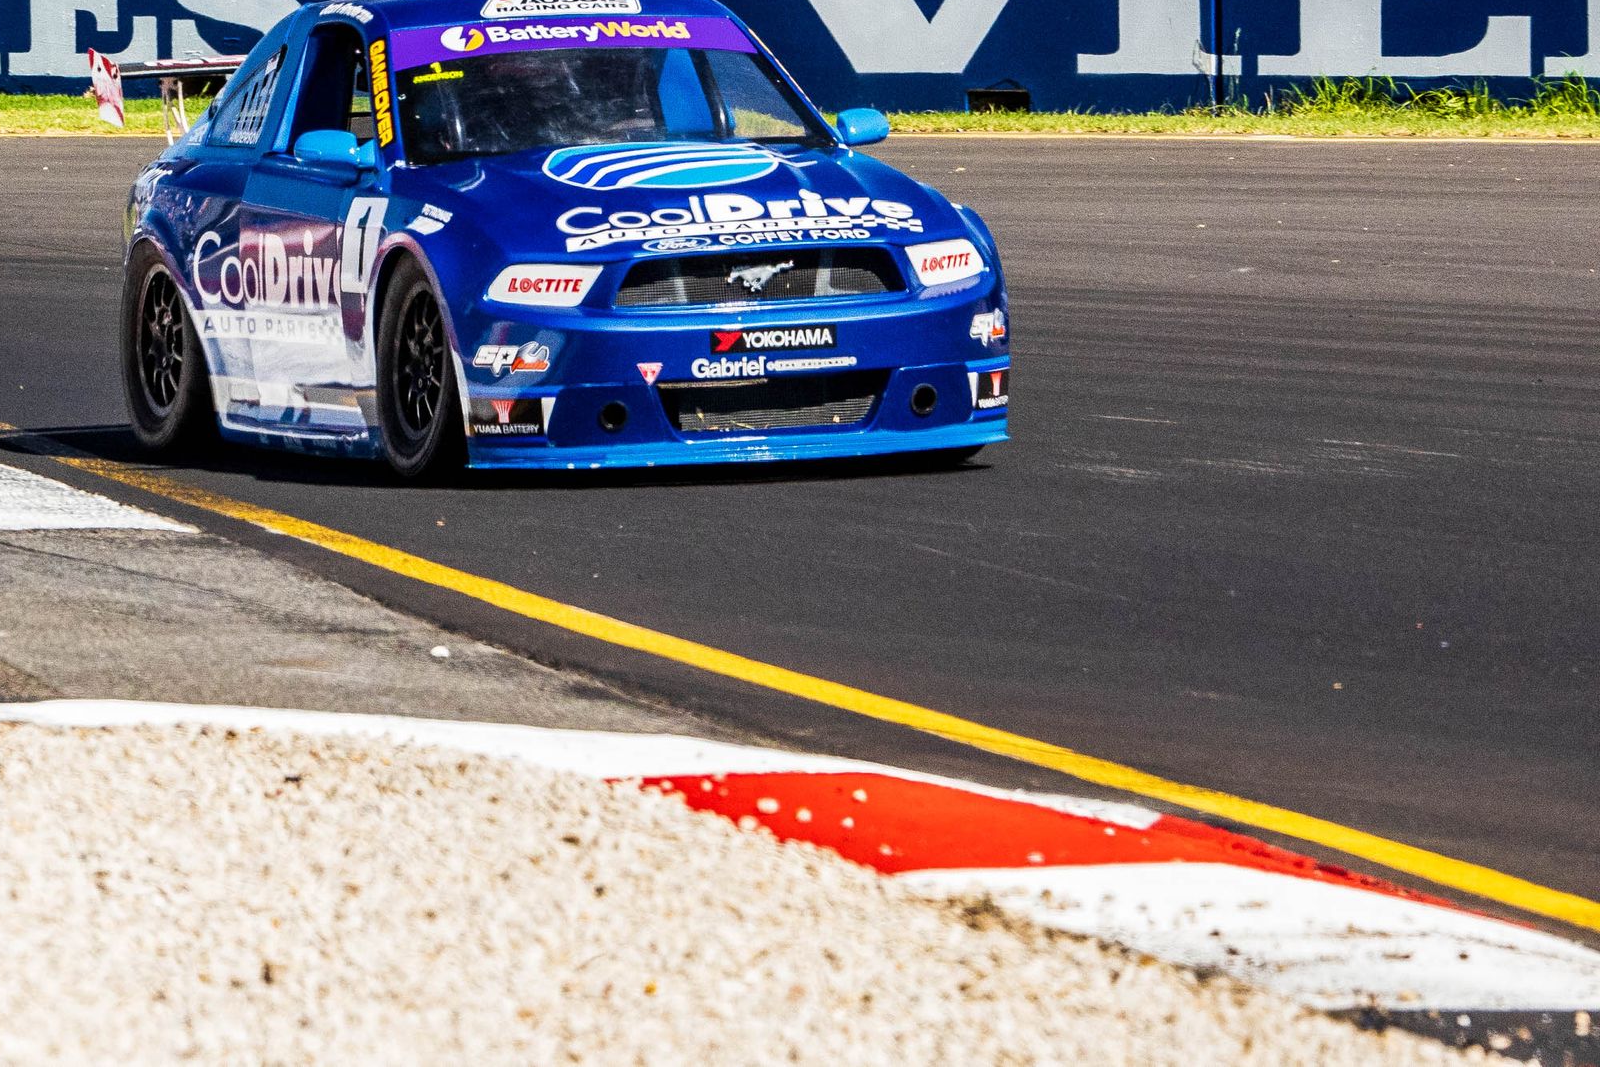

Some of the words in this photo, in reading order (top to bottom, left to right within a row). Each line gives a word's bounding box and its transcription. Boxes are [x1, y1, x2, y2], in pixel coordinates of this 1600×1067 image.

[496, 3, 571, 13] RACING
[578, 2, 629, 10] CARS
[430, 62, 442, 73] 1
[556, 189, 914, 234] CoolDrive
[580, 227, 681, 246] AUTO
[708, 219, 831, 231] PARTS
[719, 230, 803, 246] COFFEY
[809, 228, 871, 240] FORD
[656, 236, 700, 251] Ford
[921, 253, 971, 273] LOCTITE
[508, 278, 583, 293] LOCTITE
[204, 317, 256, 334] AUTO
[743, 328, 833, 348] YOKOHAMA
[691, 355, 766, 378] Gabriel
[473, 424, 501, 434] YUASA
[502, 424, 539, 434] BATTERY
